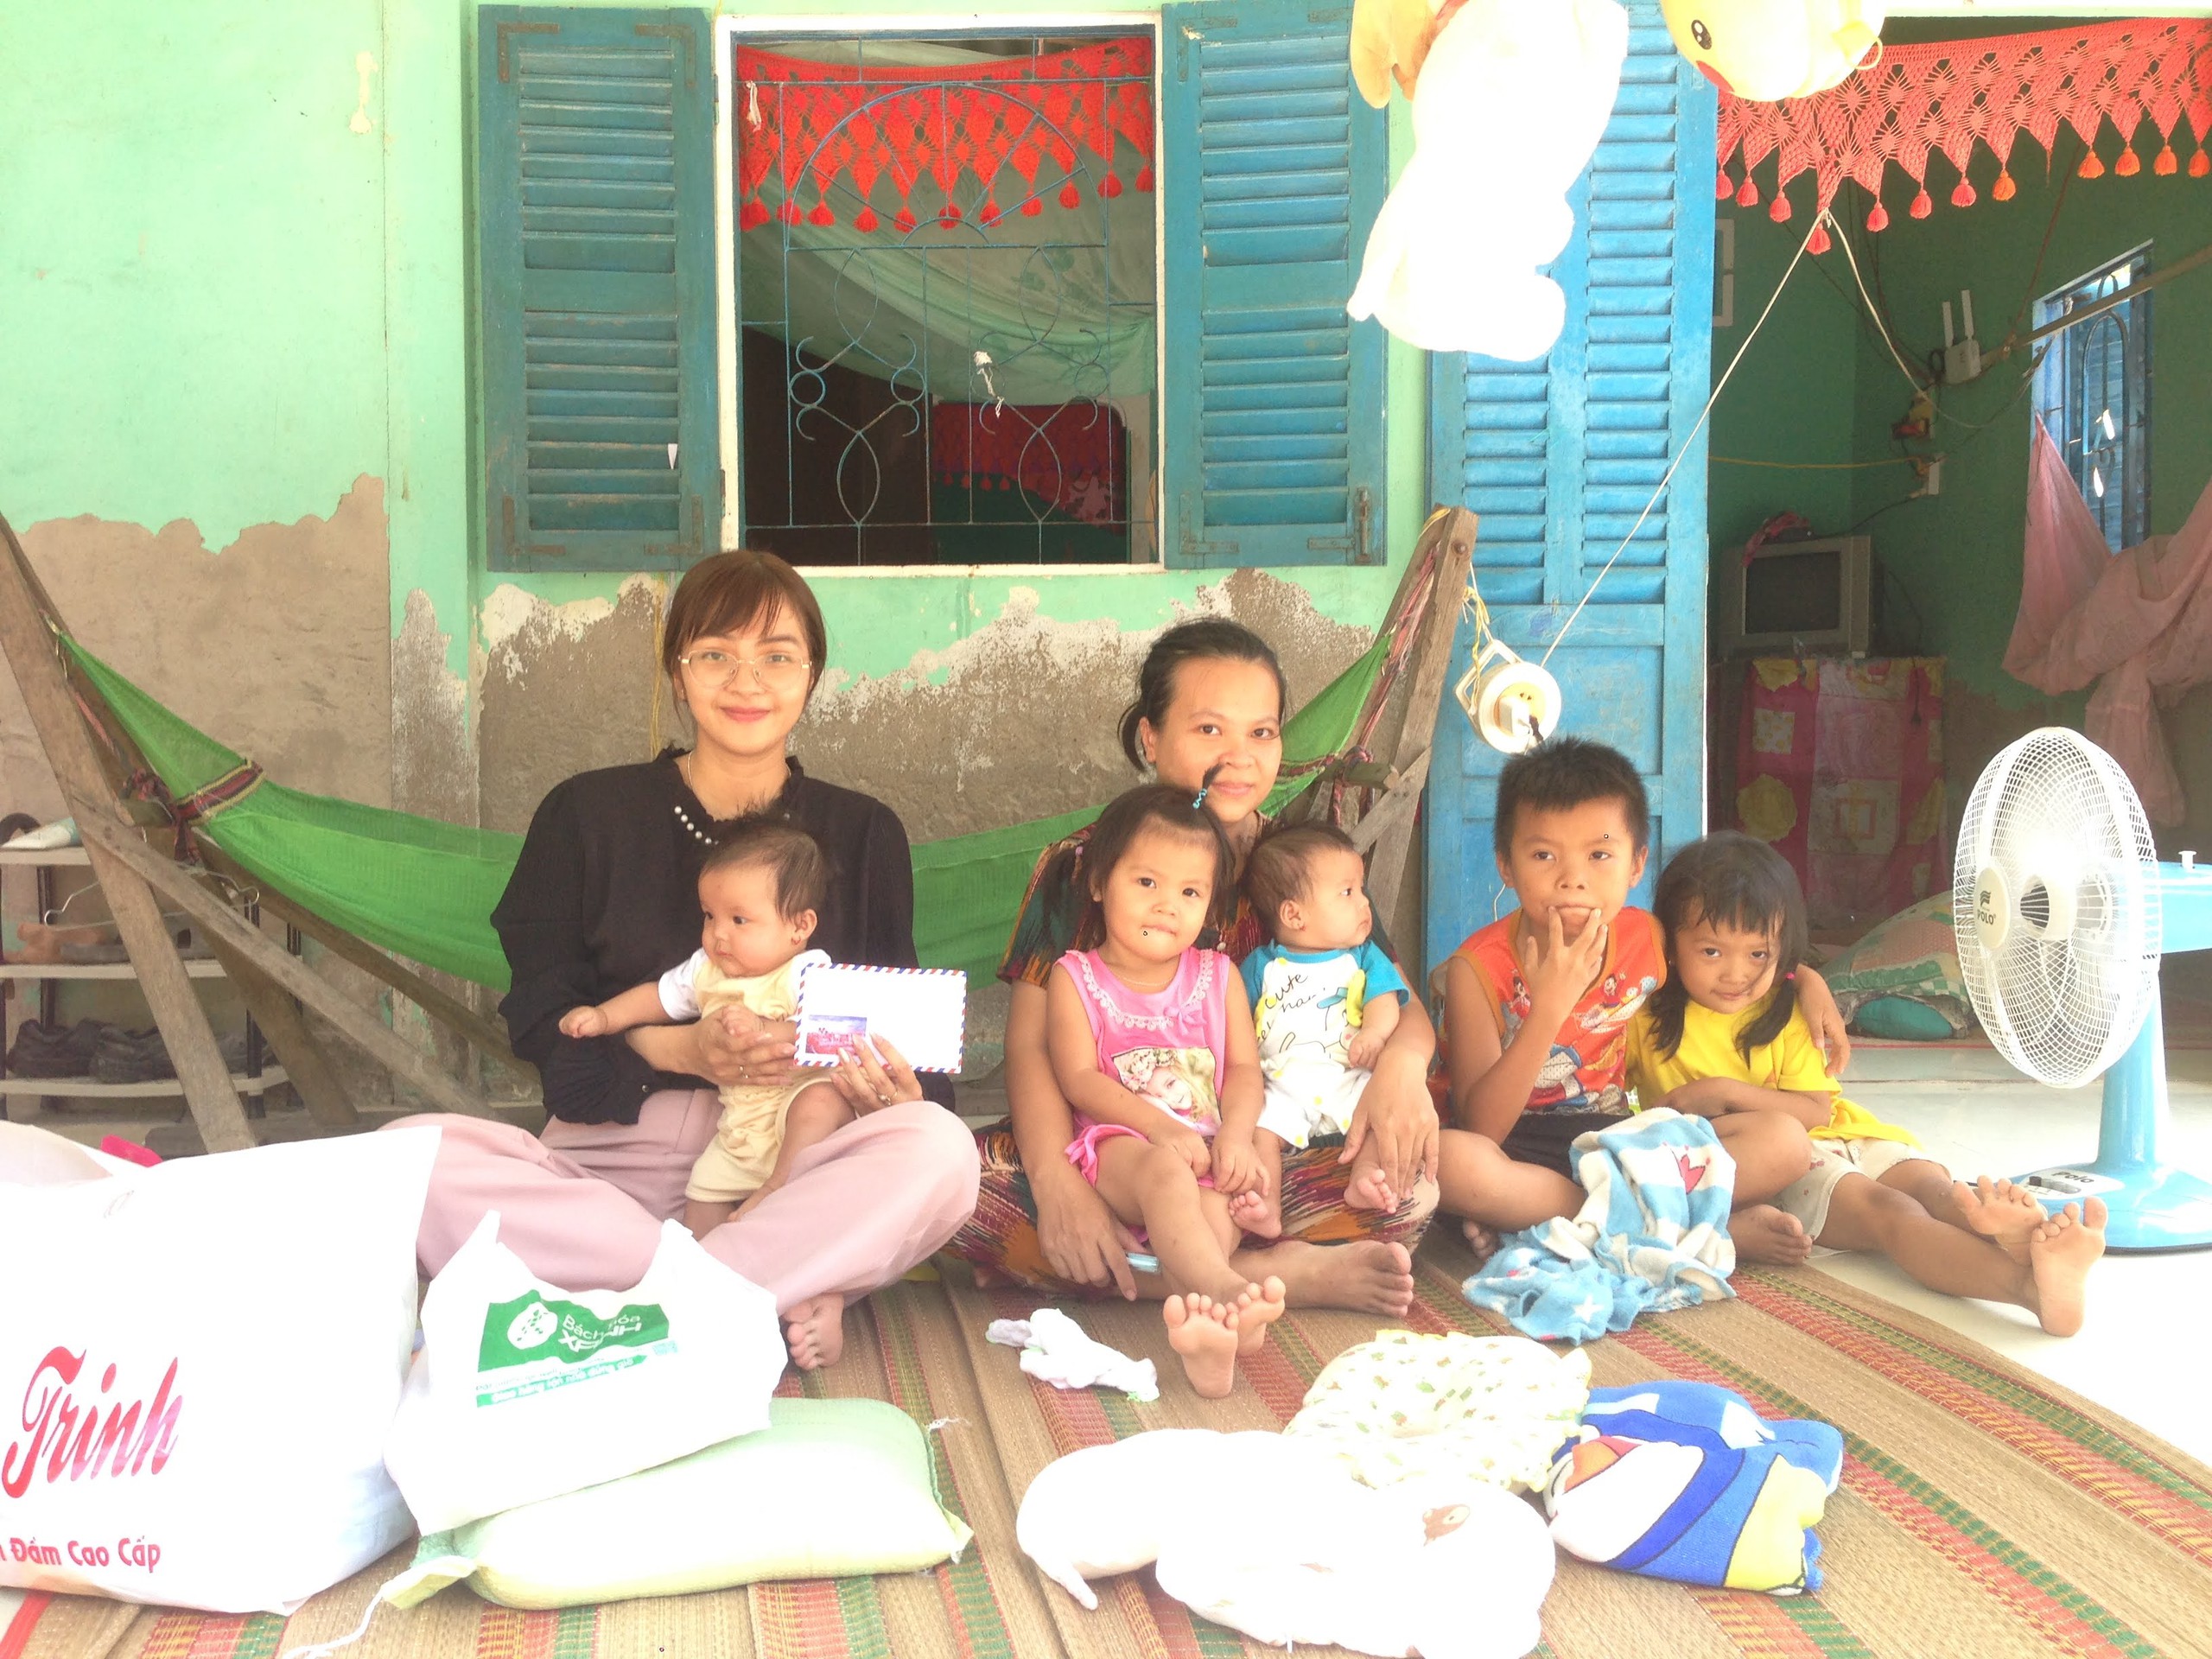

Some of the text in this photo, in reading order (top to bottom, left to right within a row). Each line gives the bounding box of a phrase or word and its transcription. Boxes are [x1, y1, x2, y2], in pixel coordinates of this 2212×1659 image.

[1977, 909, 1994, 925] POLO
[2, 1345, 183, 1498] Trinh
[67, 1541, 110, 1567] Cao
[118, 1535, 162, 1573] Cấp
